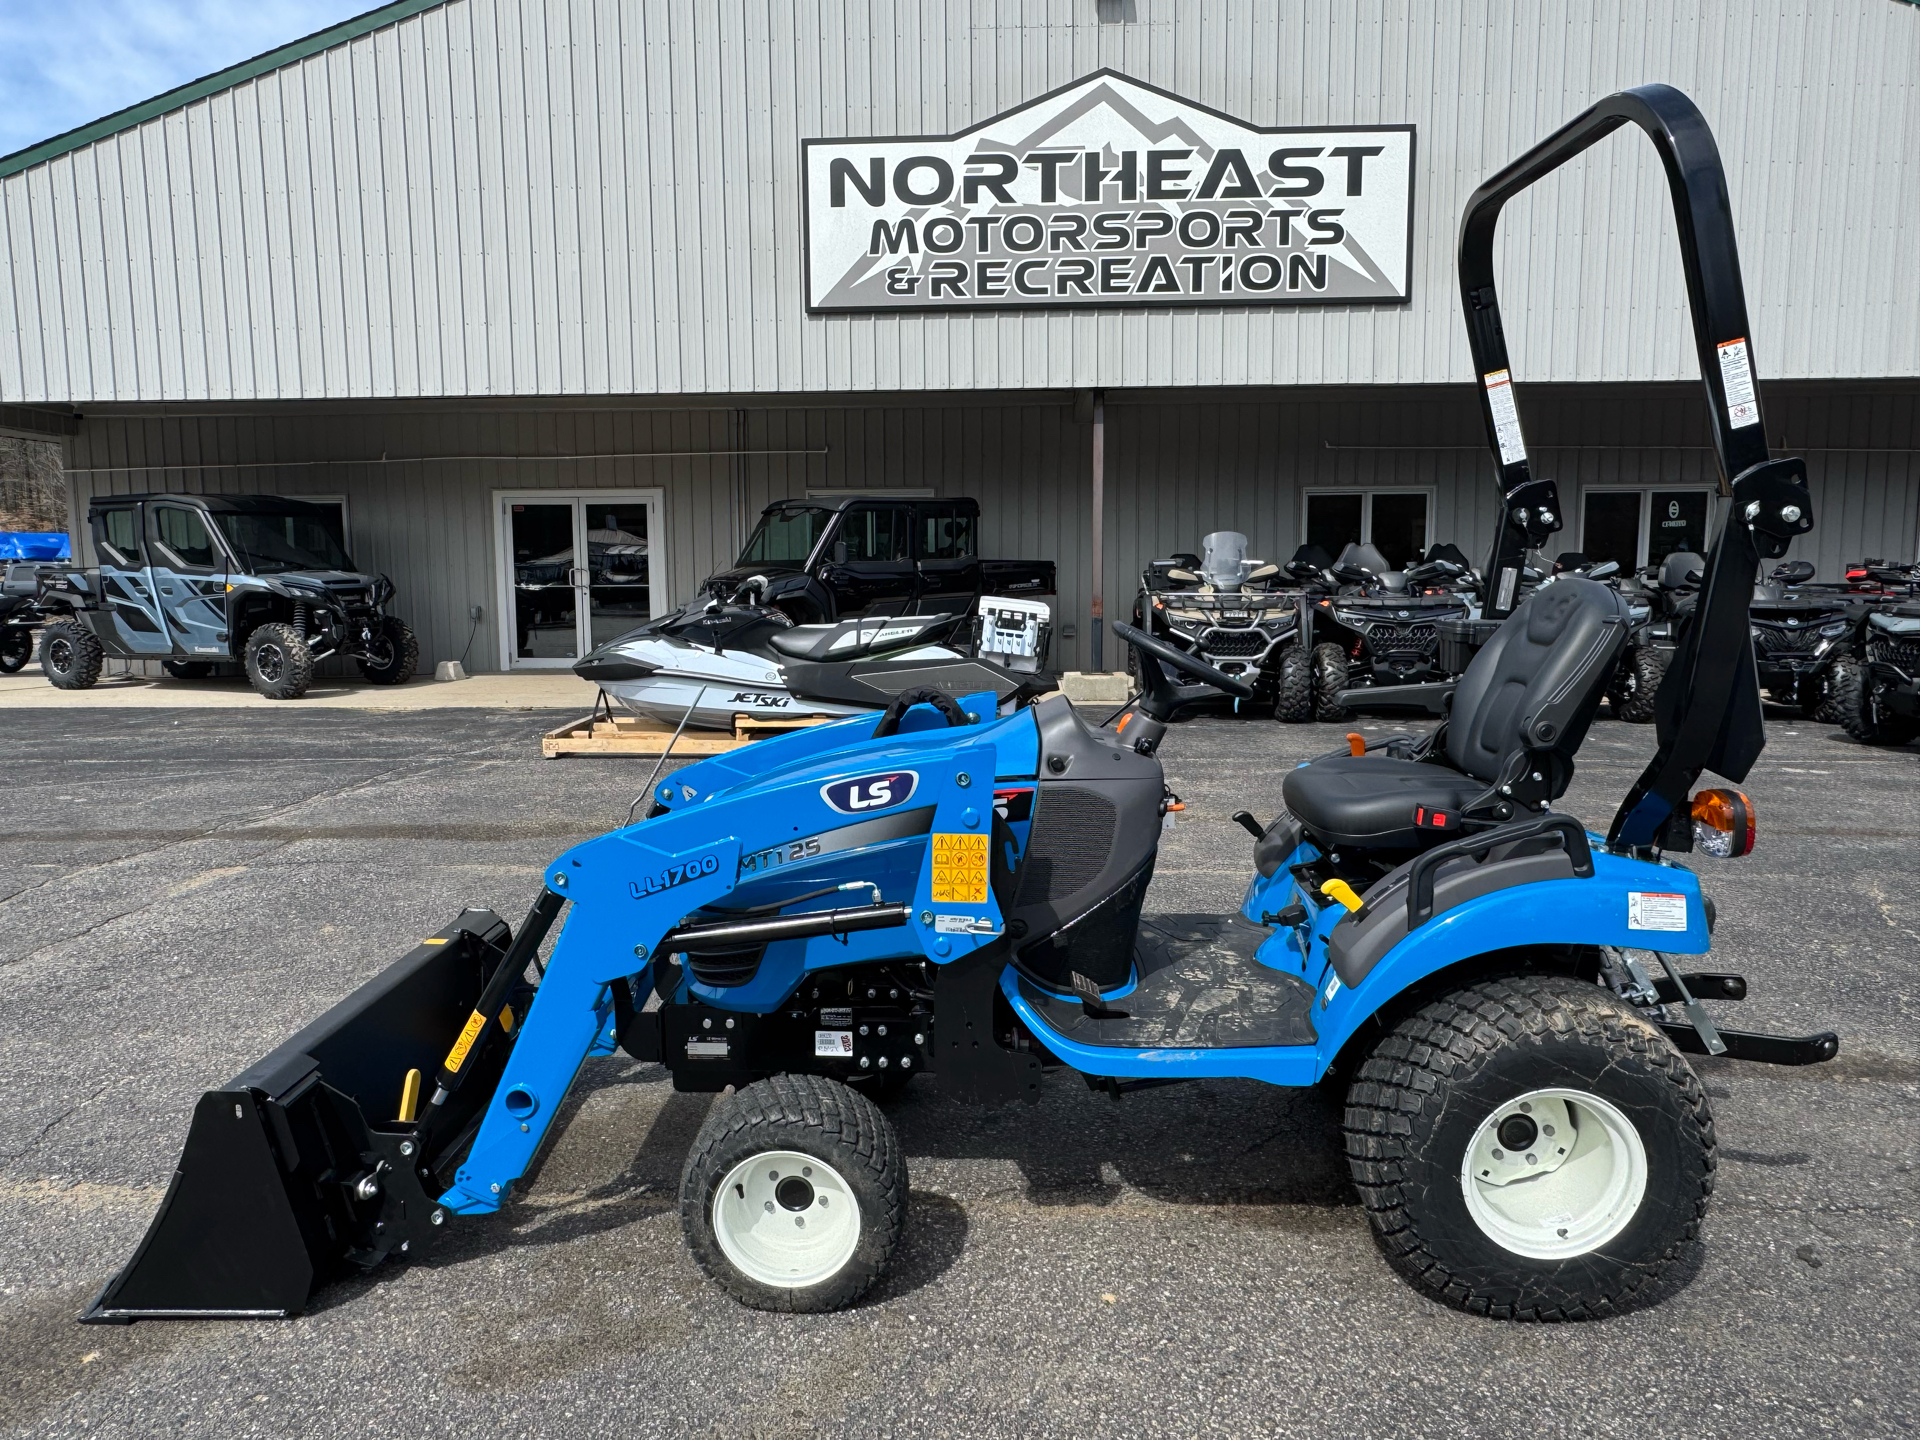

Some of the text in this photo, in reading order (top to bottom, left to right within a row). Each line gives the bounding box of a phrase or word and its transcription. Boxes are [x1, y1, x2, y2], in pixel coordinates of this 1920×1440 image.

[829, 146, 1385, 208] NORTHEAST
[868, 208, 1347, 255] MOTORSPORTS
[849, 779, 892, 809] LS
[629, 854, 720, 900] LL1700
